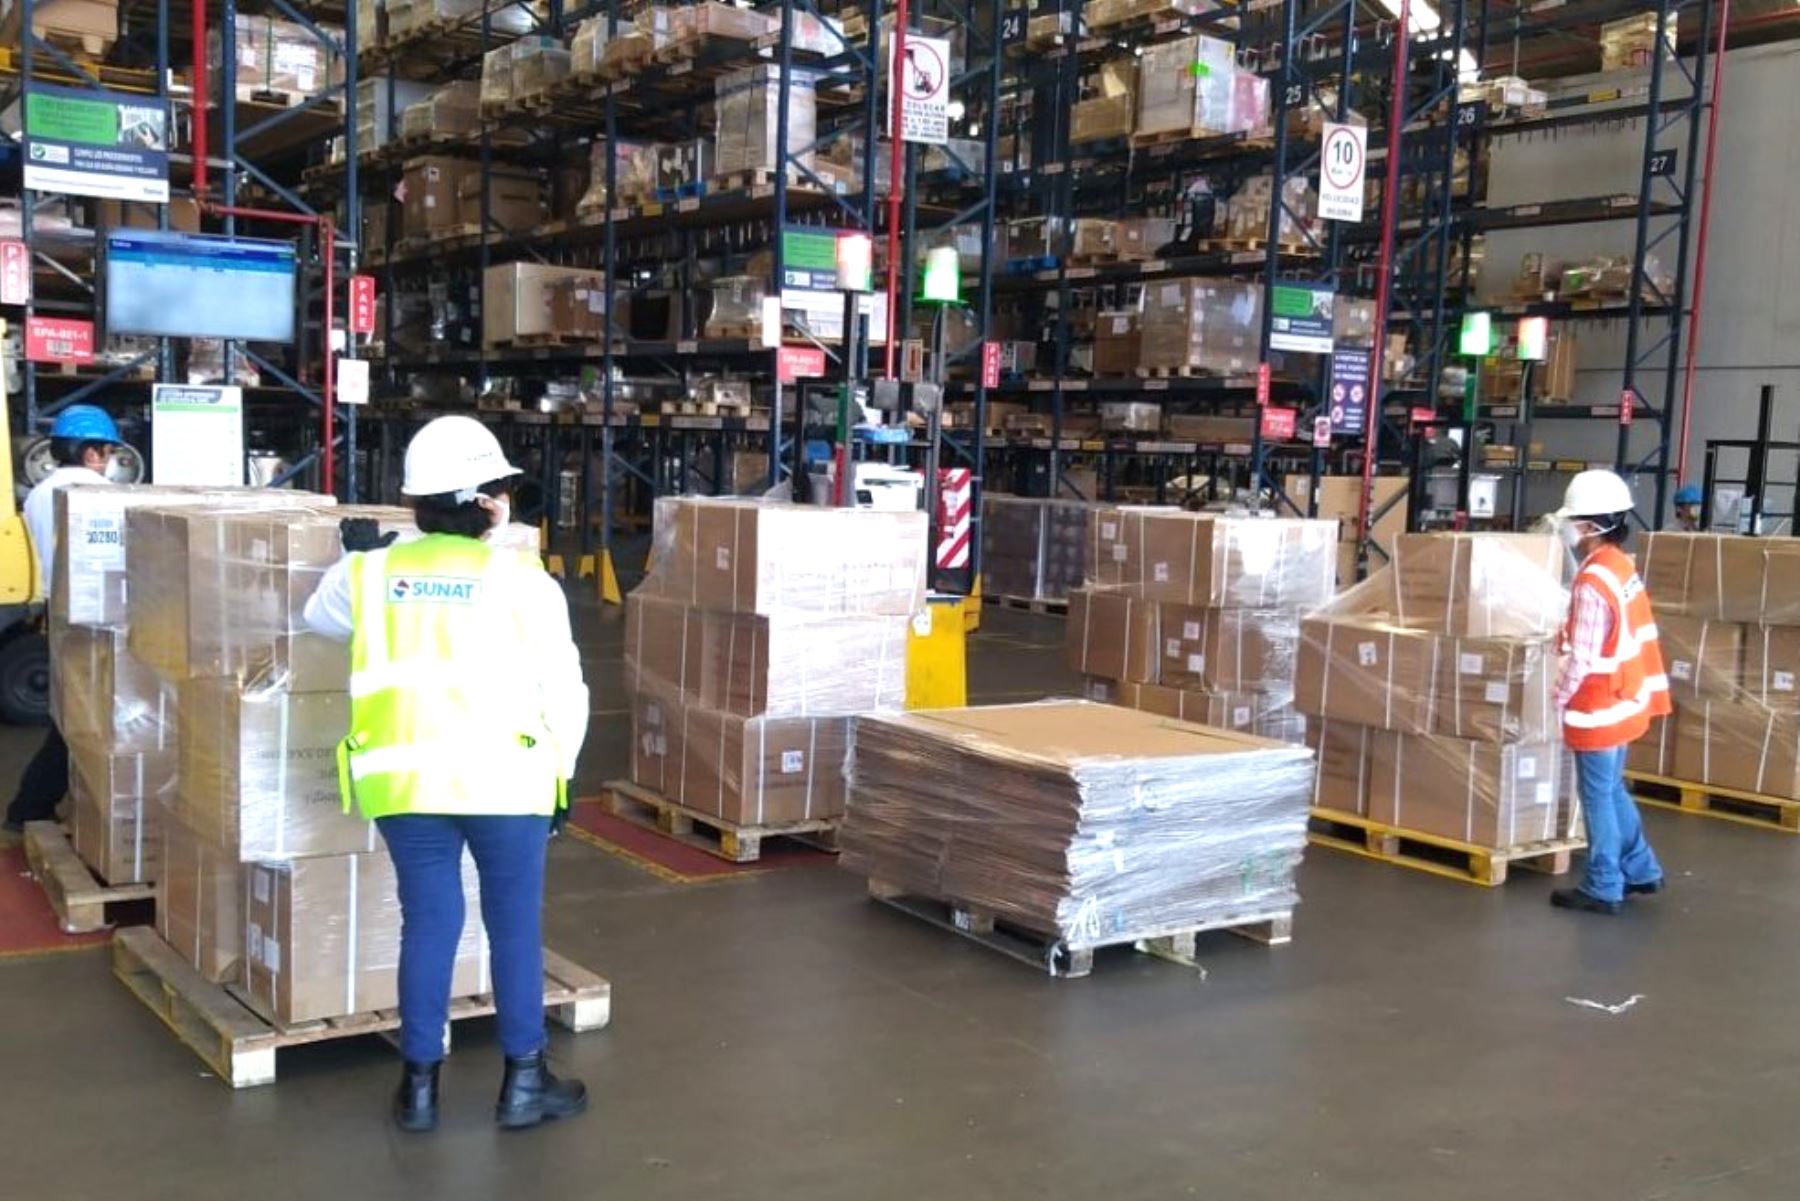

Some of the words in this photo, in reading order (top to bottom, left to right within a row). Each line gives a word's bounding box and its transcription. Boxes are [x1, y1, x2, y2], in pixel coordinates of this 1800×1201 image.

[1002, 16, 1019, 39] 24
[1285, 85, 1302, 104] 25
[1457, 106, 1475, 124] 26
[1333, 139, 1353, 165] 10
[1651, 155, 1668, 172] 27
[358, 280, 369, 328] PARE
[411, 581, 475, 600] SUNAT
